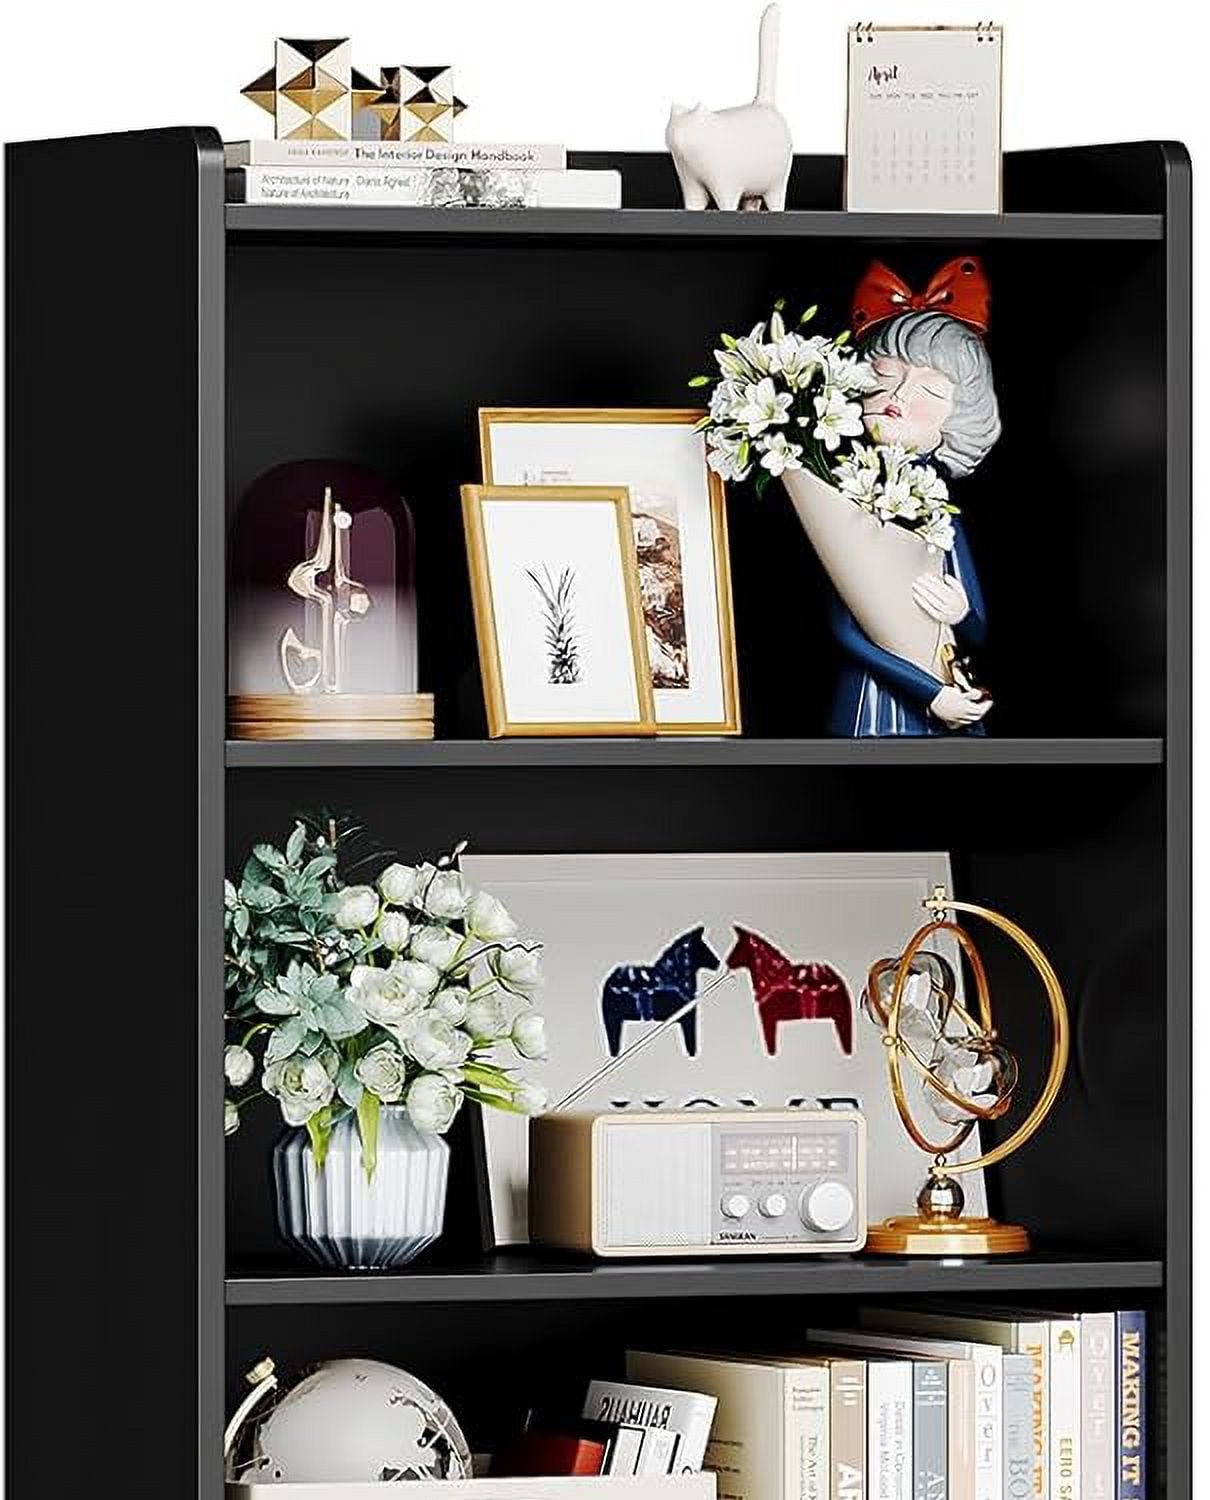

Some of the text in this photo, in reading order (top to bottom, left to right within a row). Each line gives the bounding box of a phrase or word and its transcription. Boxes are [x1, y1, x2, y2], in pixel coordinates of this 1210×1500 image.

[355, 147, 376, 160] The
[378, 148, 423, 161] Interior
[425, 148, 467, 163] Design
[471, 149, 535, 162] Handbook
[1122, 1331, 1140, 1448] MAKING
[807, 1436, 818, 1456] The
[1059, 1437, 1073, 1478] EERO
[806, 1458, 818, 1478] Art
[1122, 1455, 1140, 1486] IT
